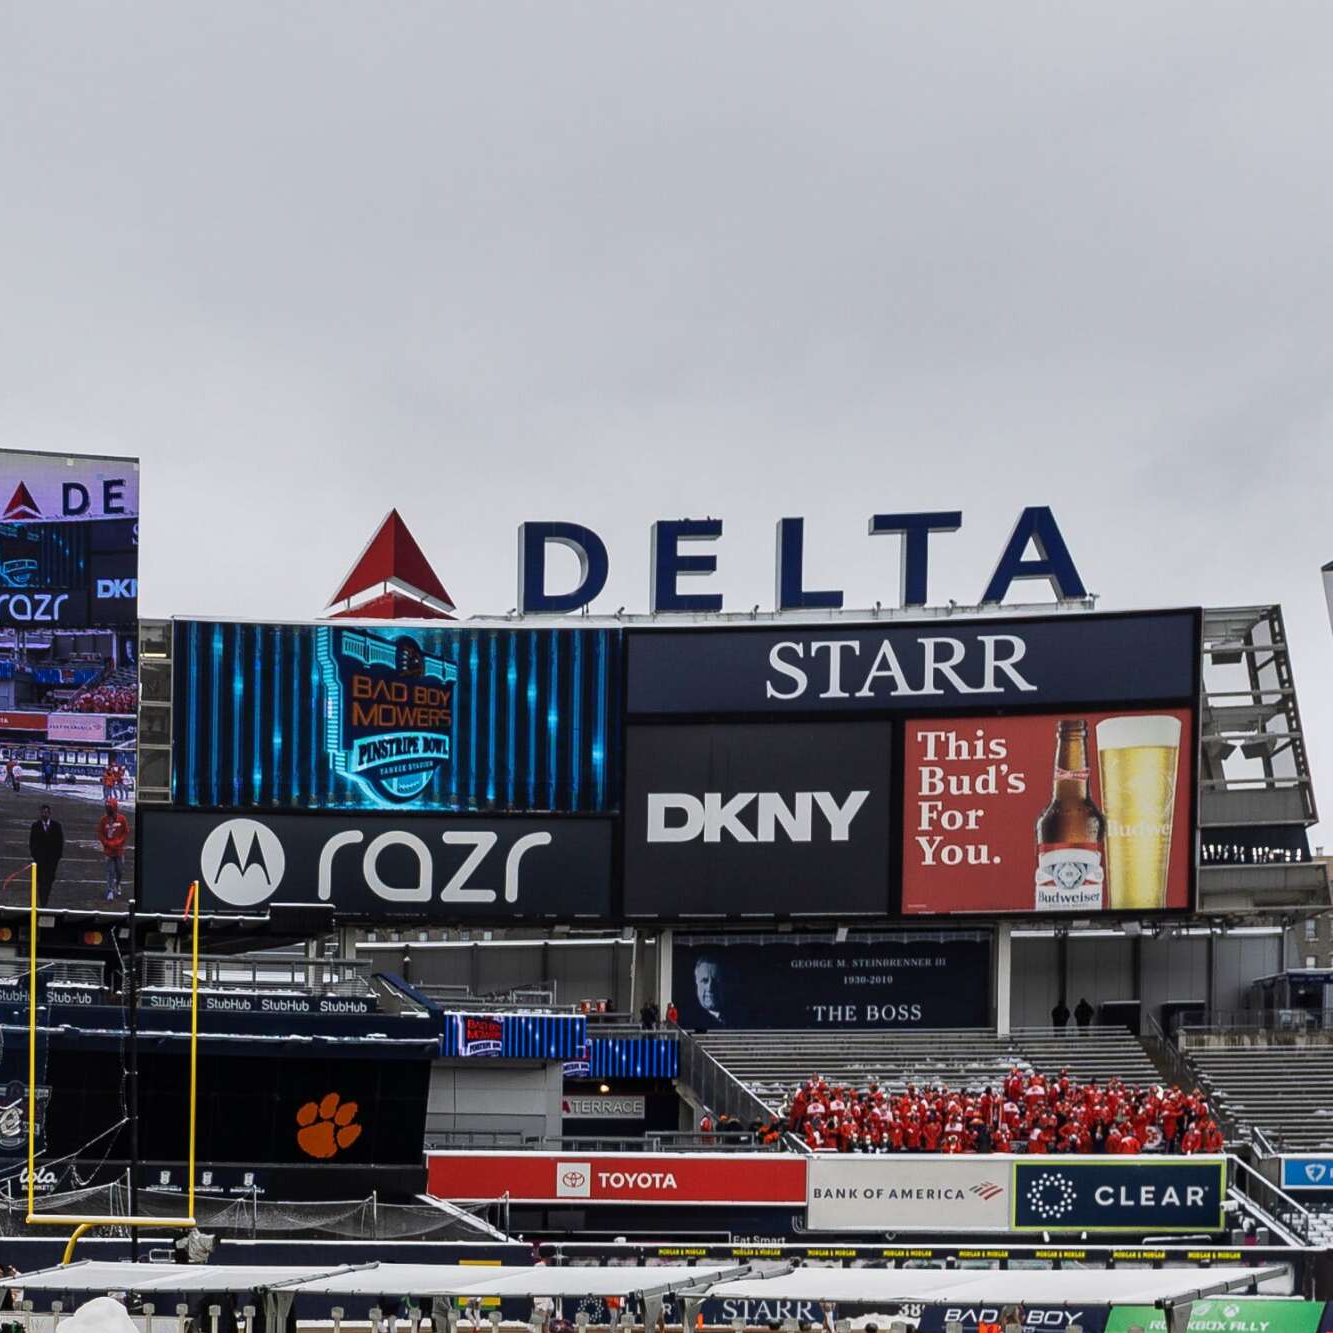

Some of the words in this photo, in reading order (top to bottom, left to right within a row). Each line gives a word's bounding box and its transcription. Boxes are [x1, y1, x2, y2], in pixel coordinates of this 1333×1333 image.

[517, 506, 1088, 615] DELTA
[766, 635, 1037, 699] STARR
[352, 675, 408, 702] BAD
[414, 685, 451, 706] BOY
[352, 701, 451, 727] MOWERS
[357, 736, 420, 767] PINSTRIPE
[422, 735, 449, 755] BOWL
[917, 729, 1008, 762] This
[917, 765, 1026, 797] Bud's
[647, 790, 870, 844] DKNY
[917, 801, 984, 831] For
[915, 836, 1001, 866] You.
[318, 829, 552, 903] razr
[1038, 890, 1100, 904] Budweiser
[791, 959, 833, 969] GEORGE
[852, 958, 932, 968] STEINBRENNER
[206, 998, 251, 1011] StubHub
[261, 1000, 310, 1012] StubHub
[320, 1001, 367, 1013] StubHub
[813, 1005, 857, 1022] THE
[866, 1004, 922, 1021] BOSS
[572, 1100, 643, 1114] TERRACE
[598, 1172, 677, 1189] TOYOTA
[813, 1187, 859, 1199] BANK
[863, 1188, 884, 1199] OF
[888, 1188, 965, 1200] AMERICA
[1095, 1186, 1205, 1206] CLEAR
[753, 1235, 785, 1246] Smart
[722, 1300, 815, 1322] STARR
[944, 1308, 998, 1323] BAD
[1026, 1310, 1083, 1325] BOY
